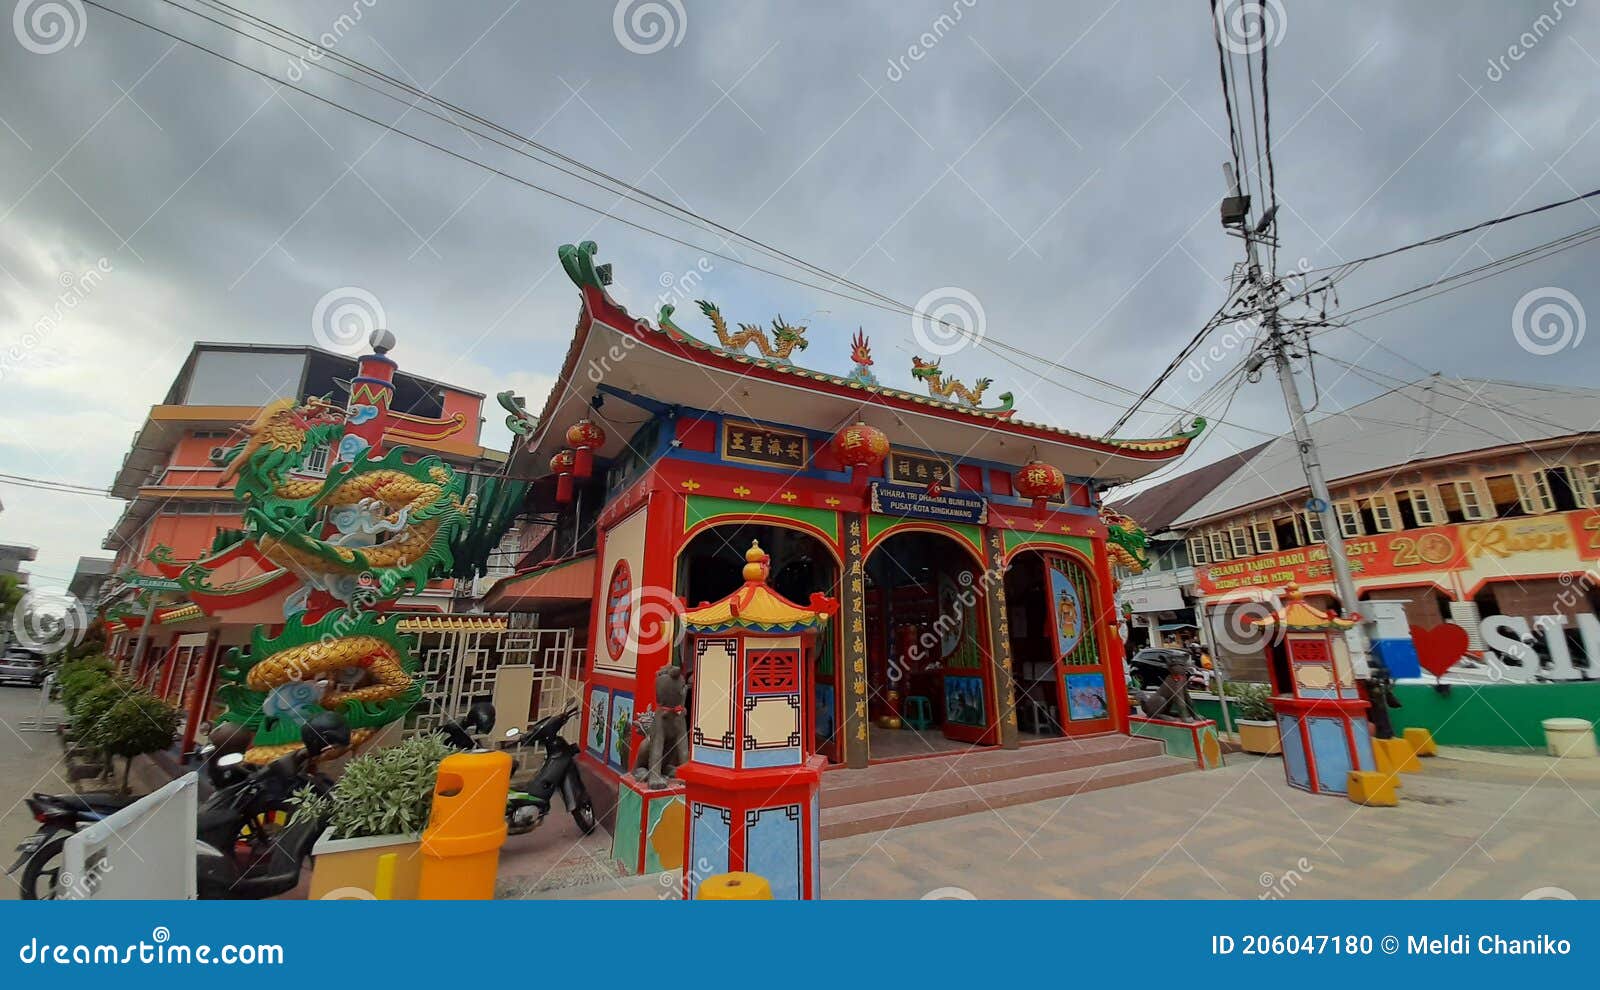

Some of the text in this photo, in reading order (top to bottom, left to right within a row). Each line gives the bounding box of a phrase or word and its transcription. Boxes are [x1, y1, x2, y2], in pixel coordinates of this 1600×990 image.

[880, 488, 906, 499] VIHARA
[906, 491, 918, 500] TRI
[965, 499, 981, 508] RAYA
[890, 501, 972, 518] PUSAT KOTA SINGKAWANG
[1209, 563, 1245, 578] SELAMAT
[1278, 552, 1305, 567] BARU
[1345, 541, 1379, 557] 2571
